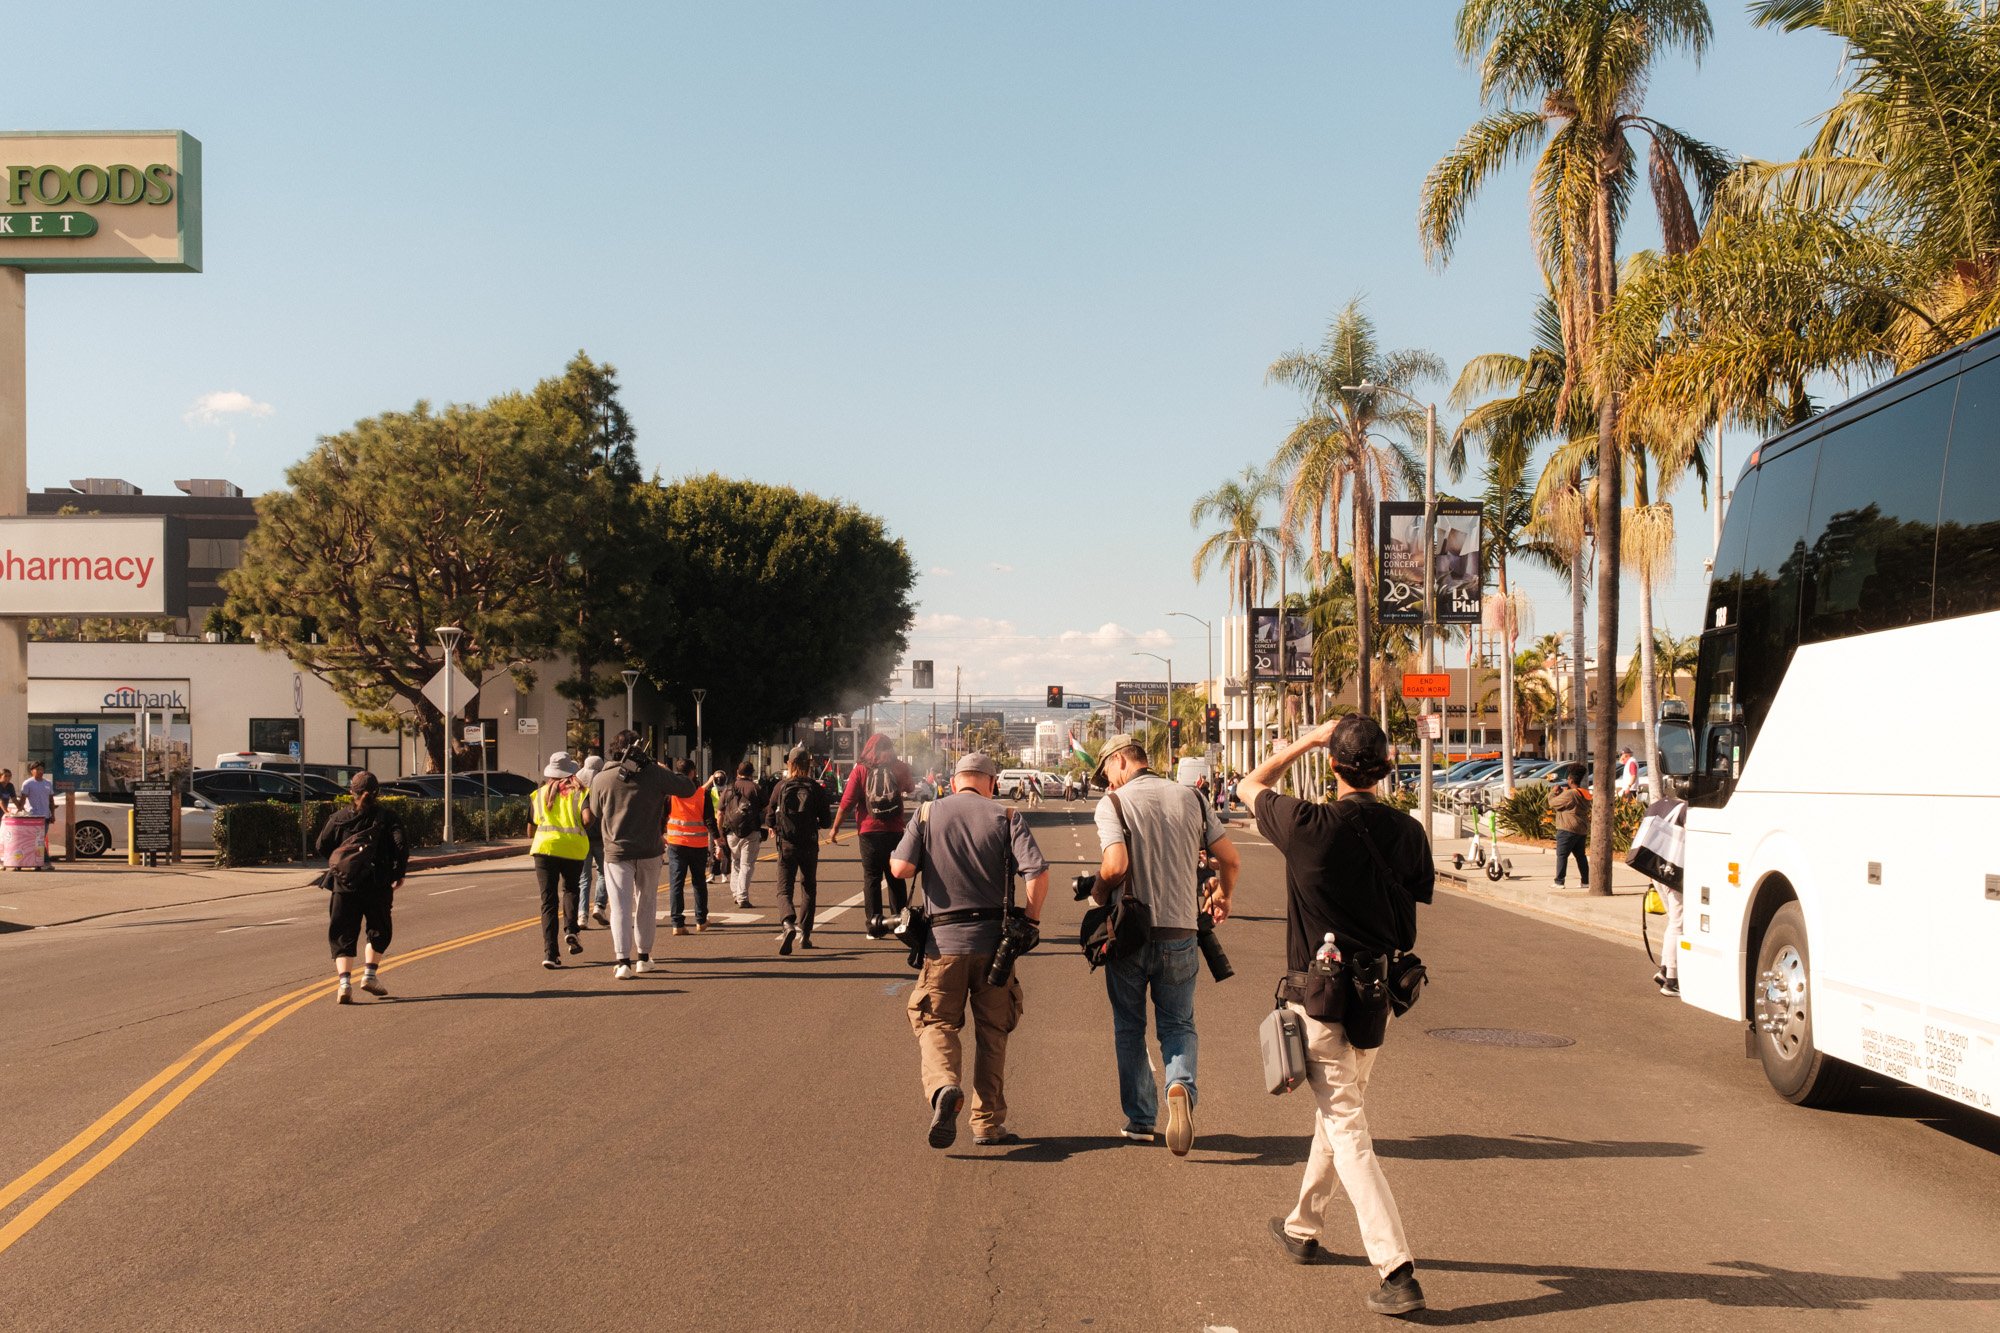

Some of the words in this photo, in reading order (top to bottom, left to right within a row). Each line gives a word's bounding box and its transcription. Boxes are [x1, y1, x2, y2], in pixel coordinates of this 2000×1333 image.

[6, 163, 173, 205] FOODS
[0, 549, 154, 588] harmacy
[1452, 588, 1469, 600] LA
[1452, 600, 1479, 613] Phil
[1295, 667, 1313, 676] Phil
[104, 687, 182, 707] citibank
[1129, 694, 1168, 705] MAESTRO
[1927, 1074, 1959, 1097] MONTEREY
[1981, 1093, 1991, 1108] CA
